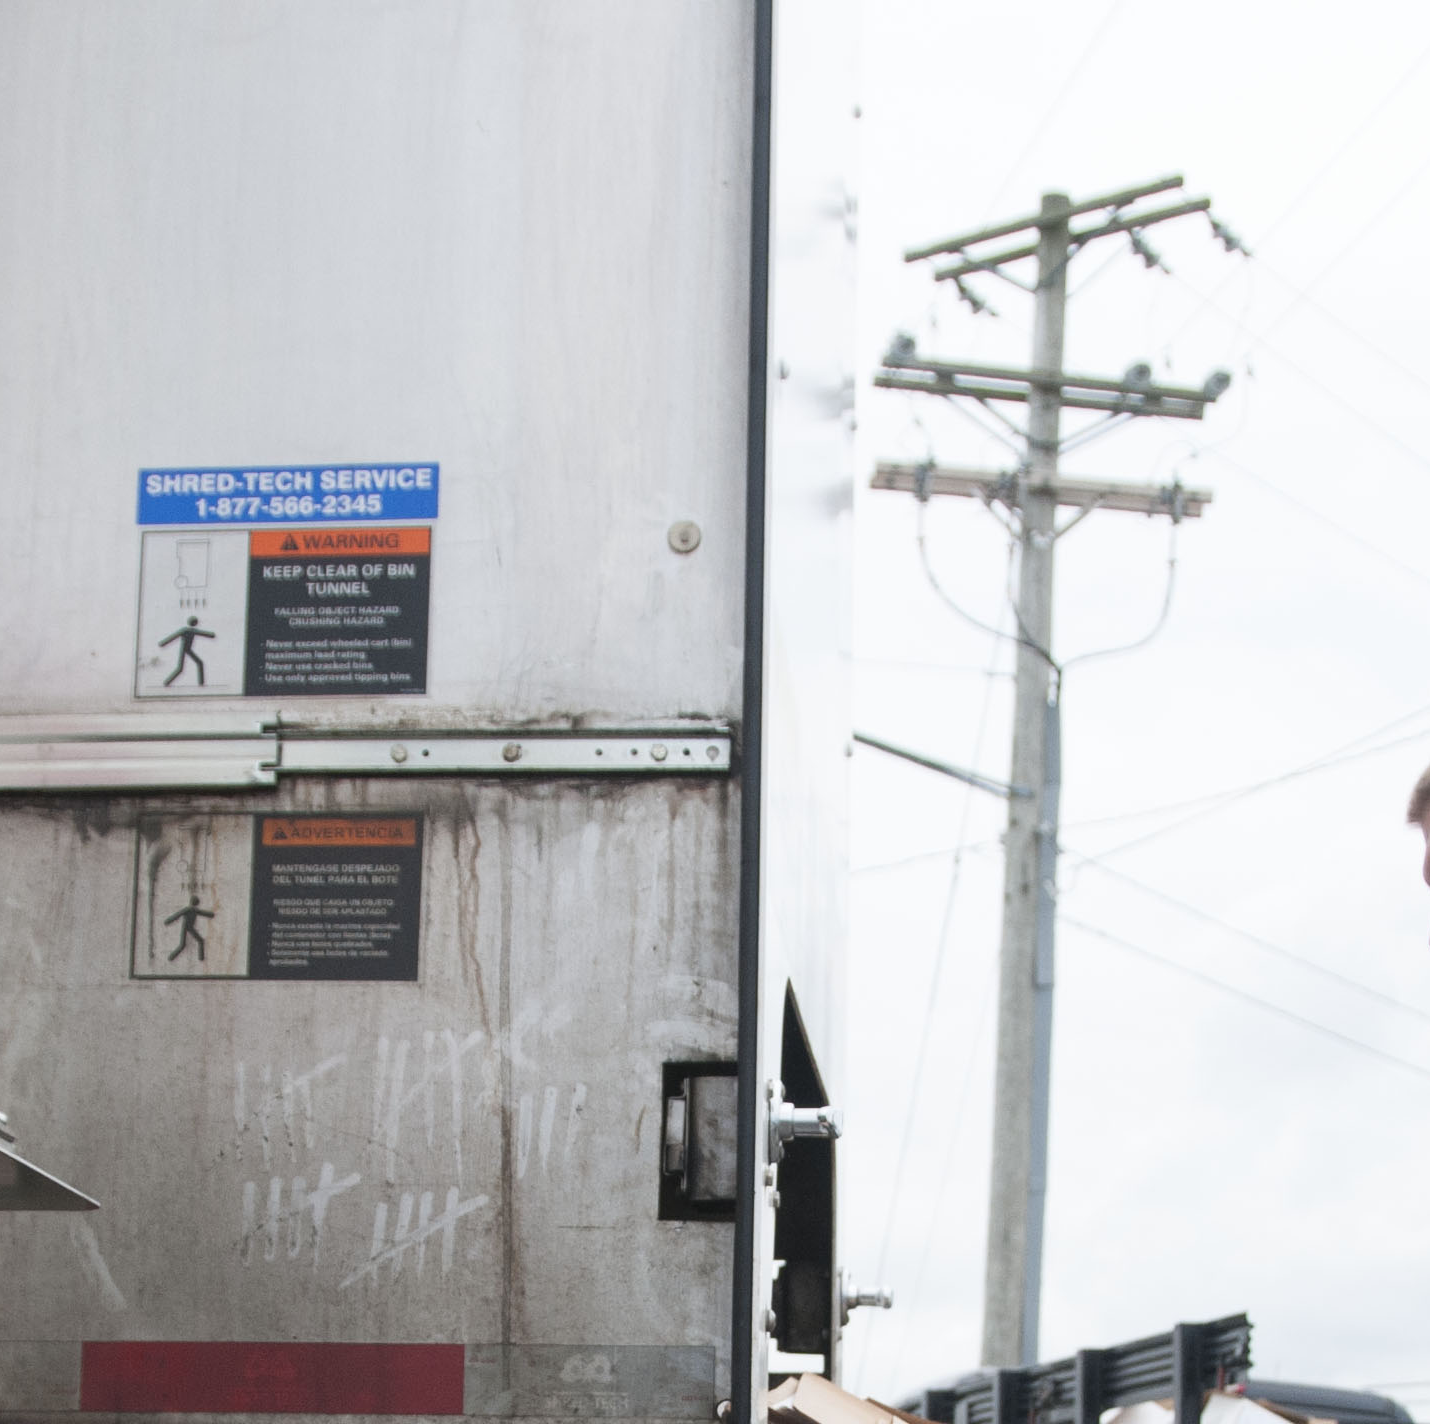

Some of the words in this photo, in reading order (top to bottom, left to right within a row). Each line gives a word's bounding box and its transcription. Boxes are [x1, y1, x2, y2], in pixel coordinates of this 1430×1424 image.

[146, 471, 313, 494] SHRED-TECH
[320, 467, 432, 490] SERVICE
[196, 494, 382, 518] 1-877-566-2345
[303, 532, 400, 549] WARNING
[262, 564, 302, 578] KEEP
[306, 564, 358, 578] CLEAR
[362, 563, 384, 577] OF
[387, 563, 416, 576] BIN
[306, 581, 371, 596] TUNNEL
[274, 607, 315, 616] FALLING
[318, 606, 356, 615] OBJECT
[358, 605, 400, 615] HAZARD
[288, 617, 340, 626] CRUSHING
[343, 616, 385, 625] HAZARD
[266, 639, 293, 648] Never
[295, 639, 327, 648] exceed
[265, 662, 293, 671] Never
[264, 673, 283, 682] Use
[291, 827, 404, 839] ADVERTENCIA
[272, 863, 339, 873] MANTENGASE
[341, 863, 400, 873] DESPEJADO
[272, 875, 292, 884] DEL
[327, 875, 354, 884] PARA
[357, 875, 369, 884] EL
[372, 875, 398, 884] BOTE
